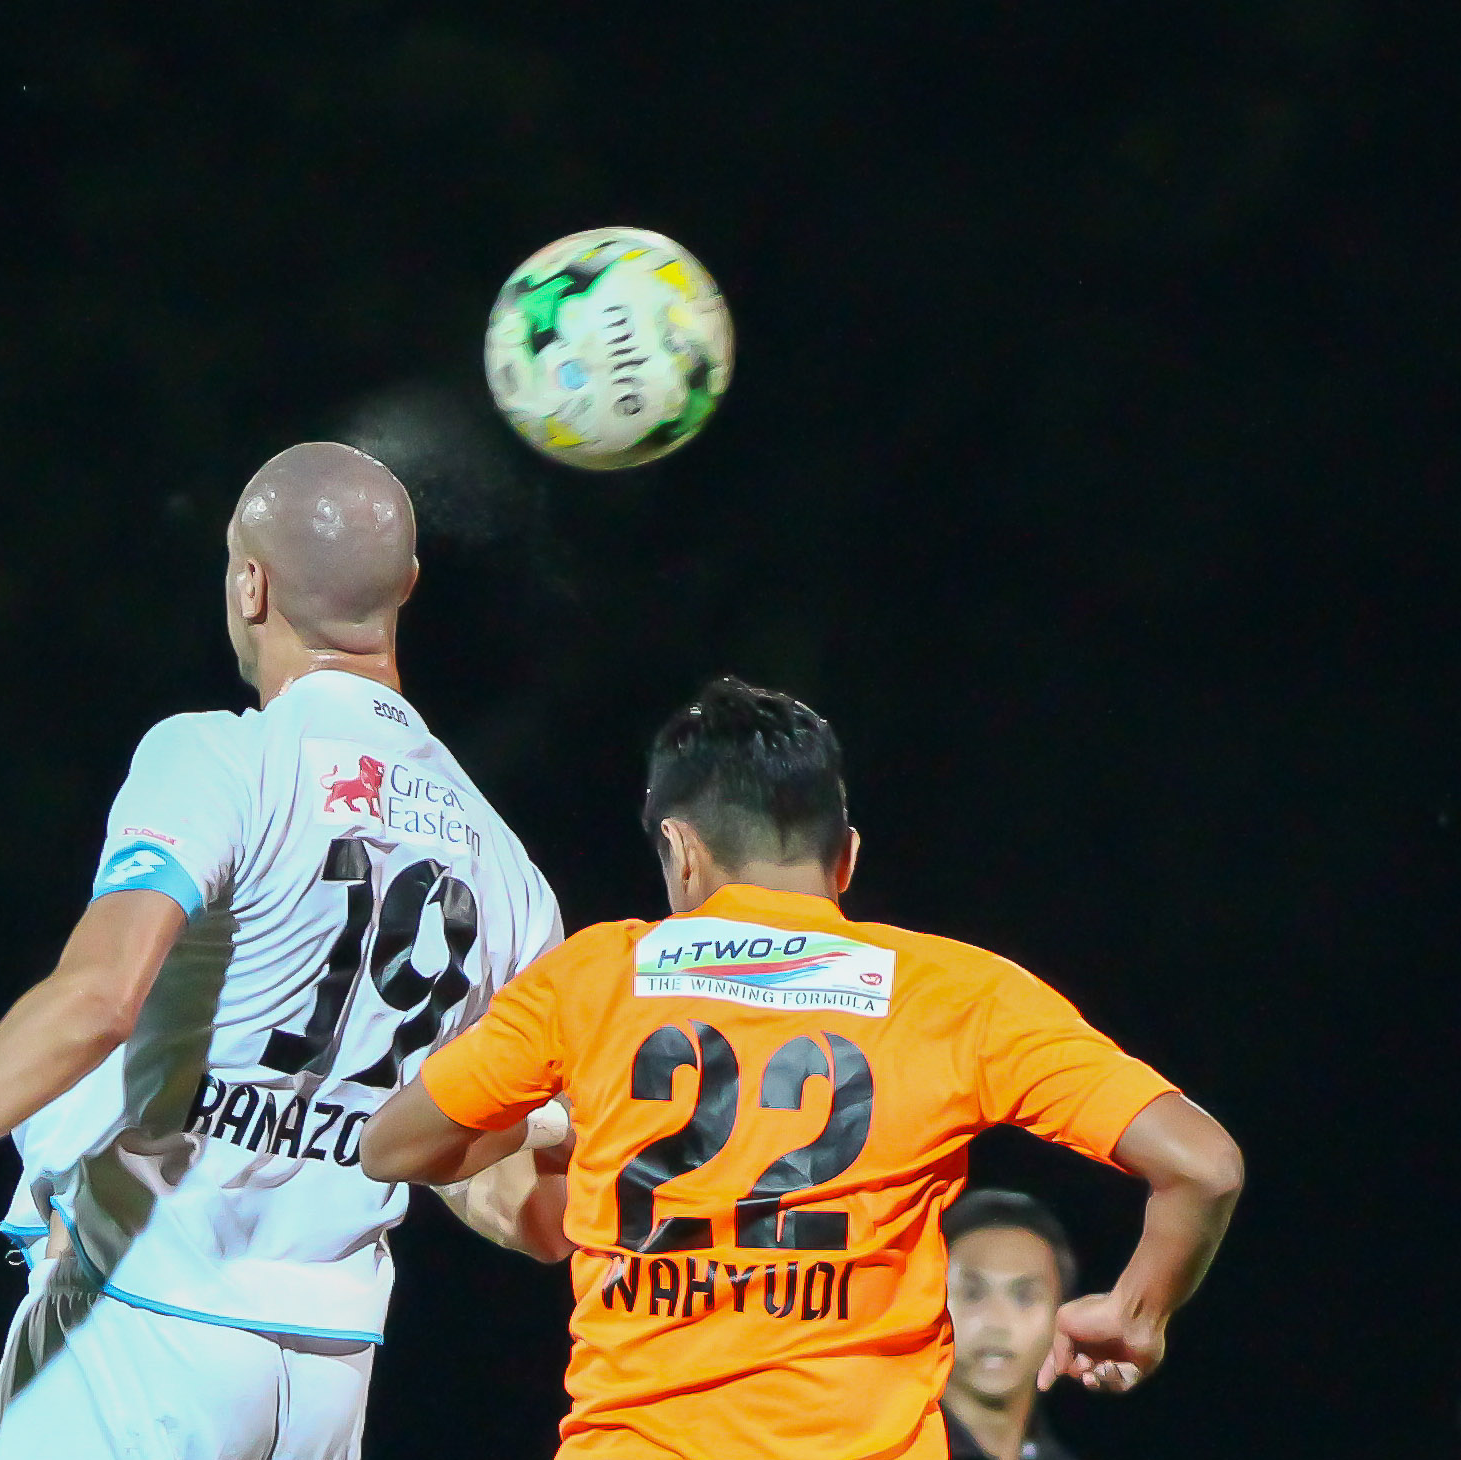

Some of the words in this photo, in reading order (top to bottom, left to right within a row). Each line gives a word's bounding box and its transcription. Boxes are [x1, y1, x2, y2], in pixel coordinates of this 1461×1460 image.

[372, 698, 410, 728] 2000
[259, 837, 479, 1090] 19
[657, 936, 807, 969] H-TWO-O
[647, 977, 682, 992] THE
[690, 977, 775, 1004] WINNING
[782, 991, 876, 1013] FORMULA
[615, 1018, 874, 1254] 22
[601, 1253, 858, 1322] WAHYUDI
